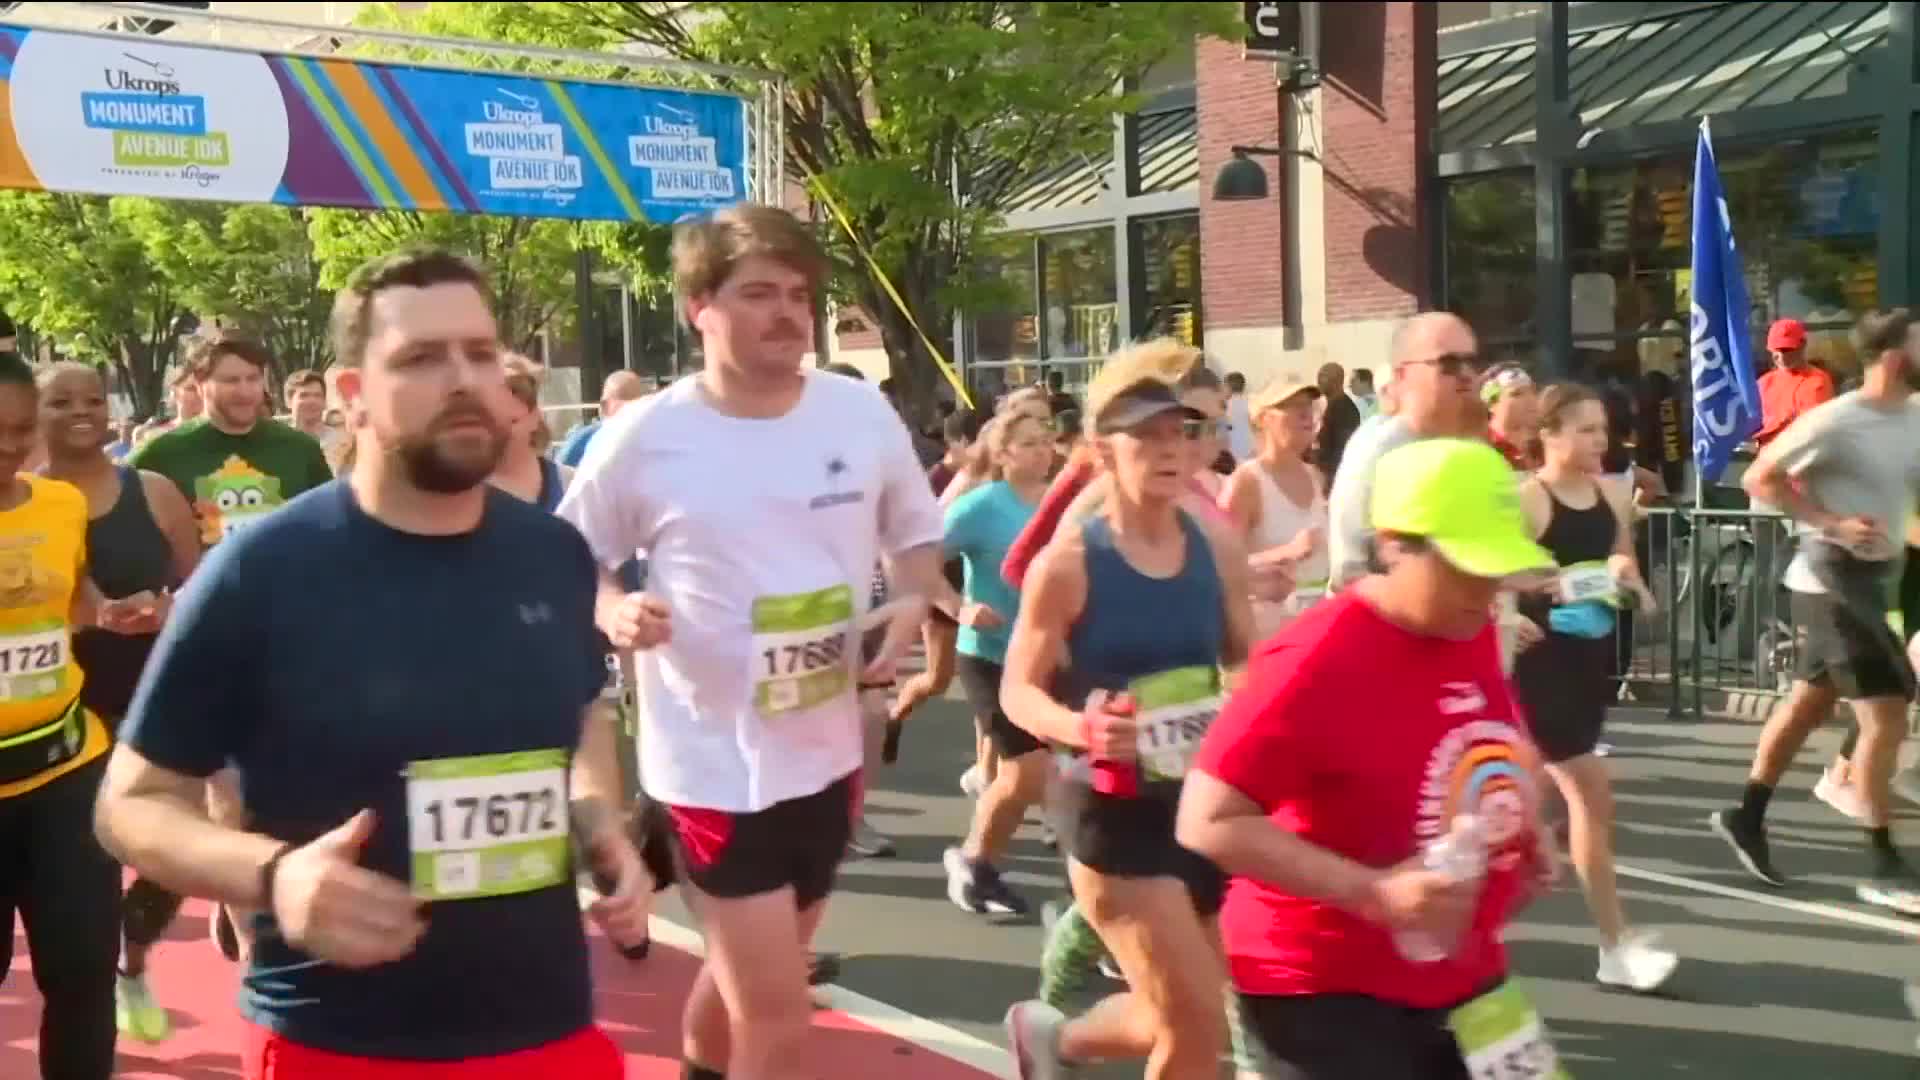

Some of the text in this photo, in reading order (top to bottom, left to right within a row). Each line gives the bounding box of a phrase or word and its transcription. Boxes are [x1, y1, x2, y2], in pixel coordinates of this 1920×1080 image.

[104, 67, 180, 98] Ukrops
[89, 100, 196, 127] MONUMENT
[120, 134, 188, 158] AVENUE
[473, 130, 554, 151] MONUMENT
[635, 143, 709, 162] MONUMENT
[496, 159, 549, 180] AVENUE
[656, 171, 705, 189] AVENUE
[423, 784, 556, 843] 17672
